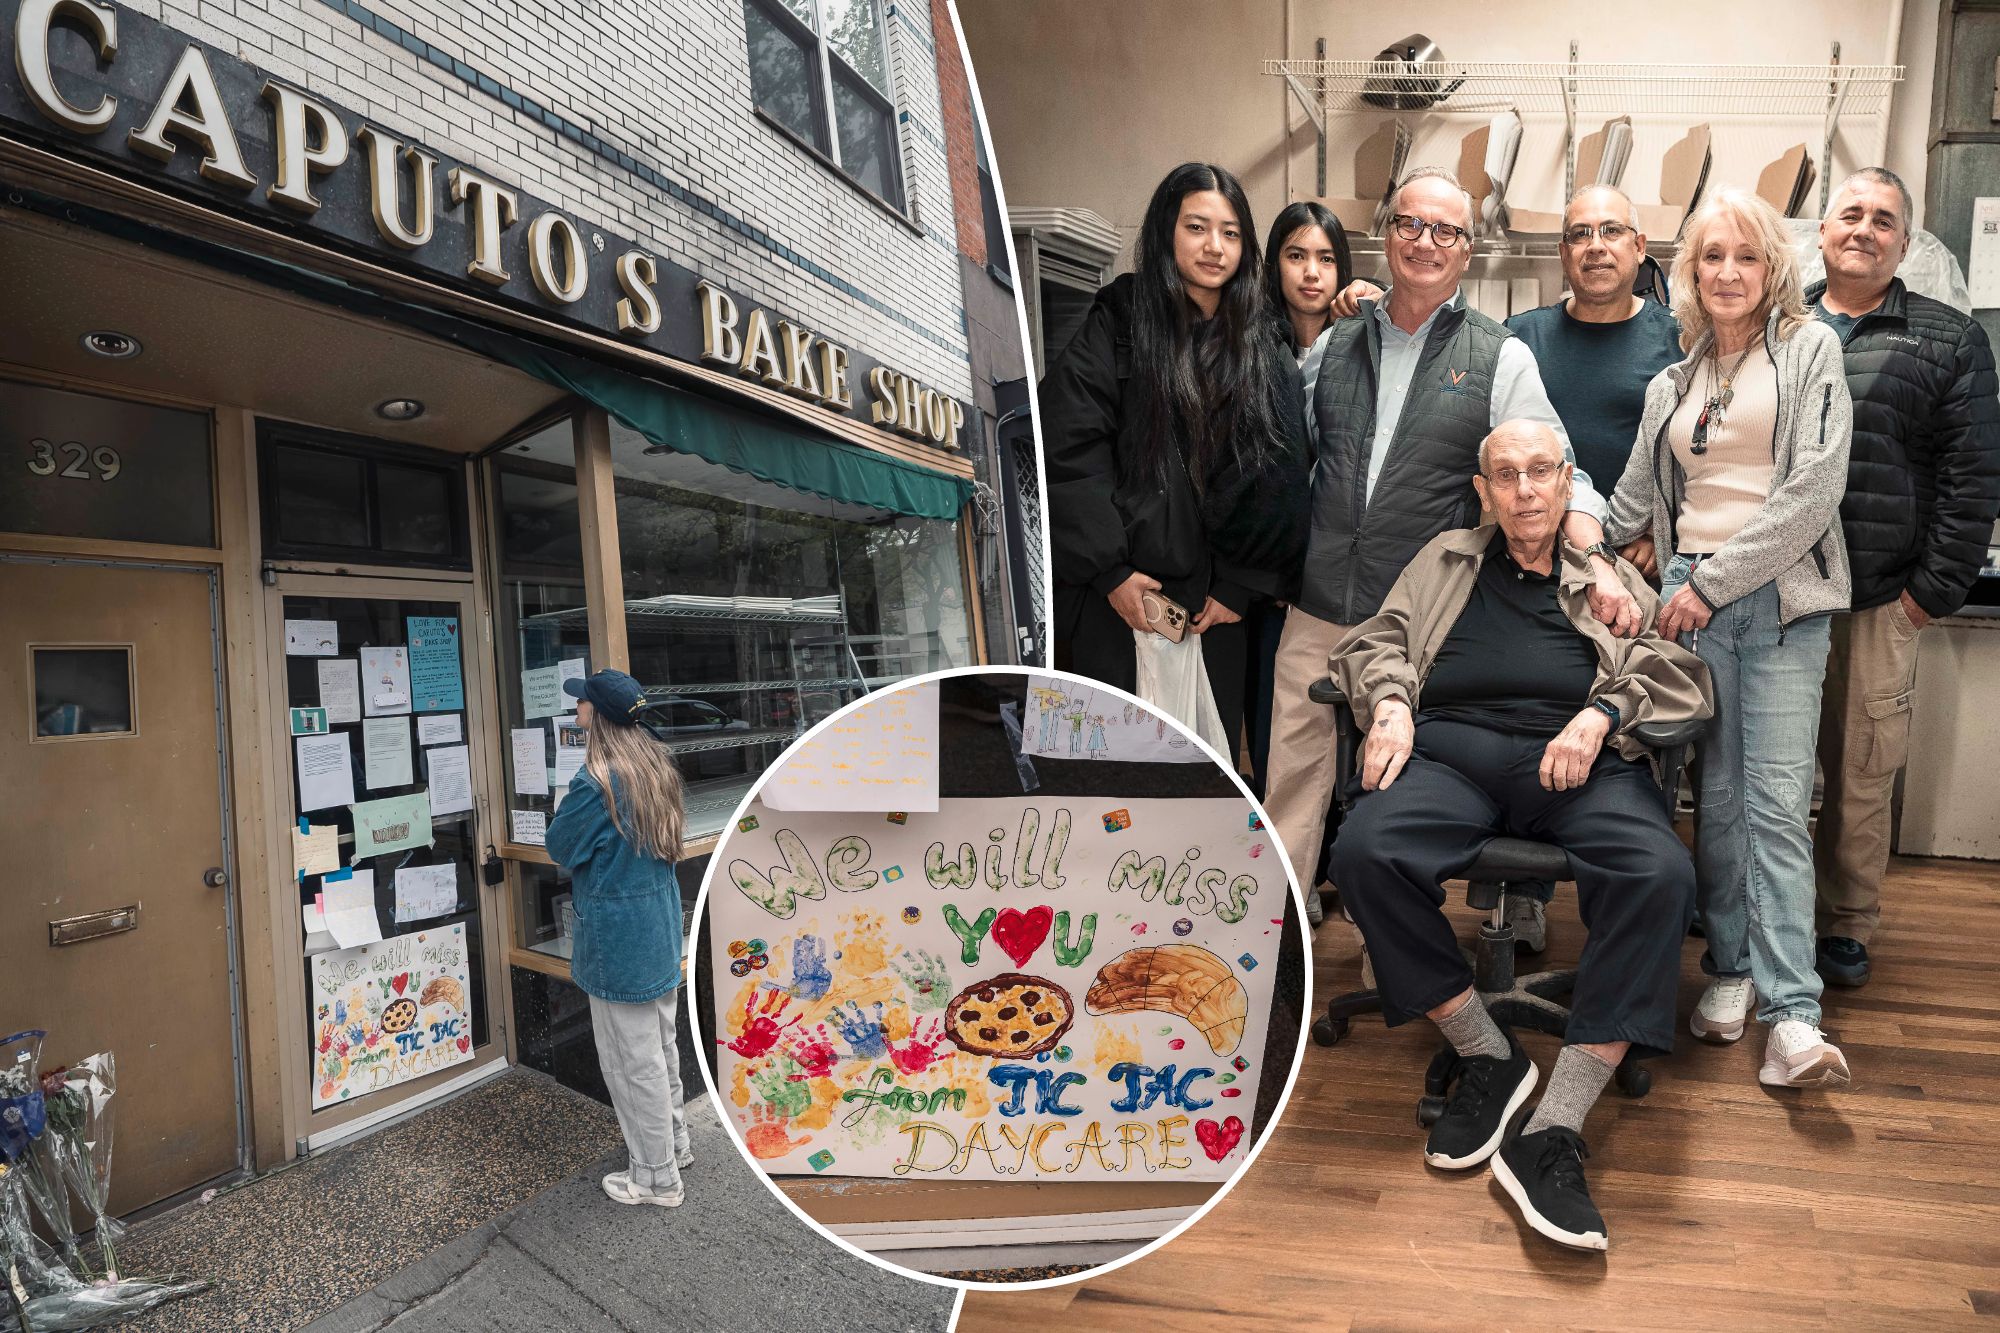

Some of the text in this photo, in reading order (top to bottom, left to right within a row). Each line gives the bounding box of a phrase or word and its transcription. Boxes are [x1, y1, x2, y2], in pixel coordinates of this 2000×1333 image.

[15, 0, 965, 453] CAPUTO'S BAKE SHOP
[1886, 335, 1919, 346] NAUTICA
[26, 437, 121, 482] 329
[413, 618, 447, 628] LOVE FOR
[728, 807, 1259, 924] We will miss
[318, 938, 461, 995] We will miss
[351, 1046, 392, 1077] from
[369, 1041, 459, 1090] DAYCARE
[842, 1066, 968, 1128] from
[893, 1117, 1194, 1176] DAYCARE
